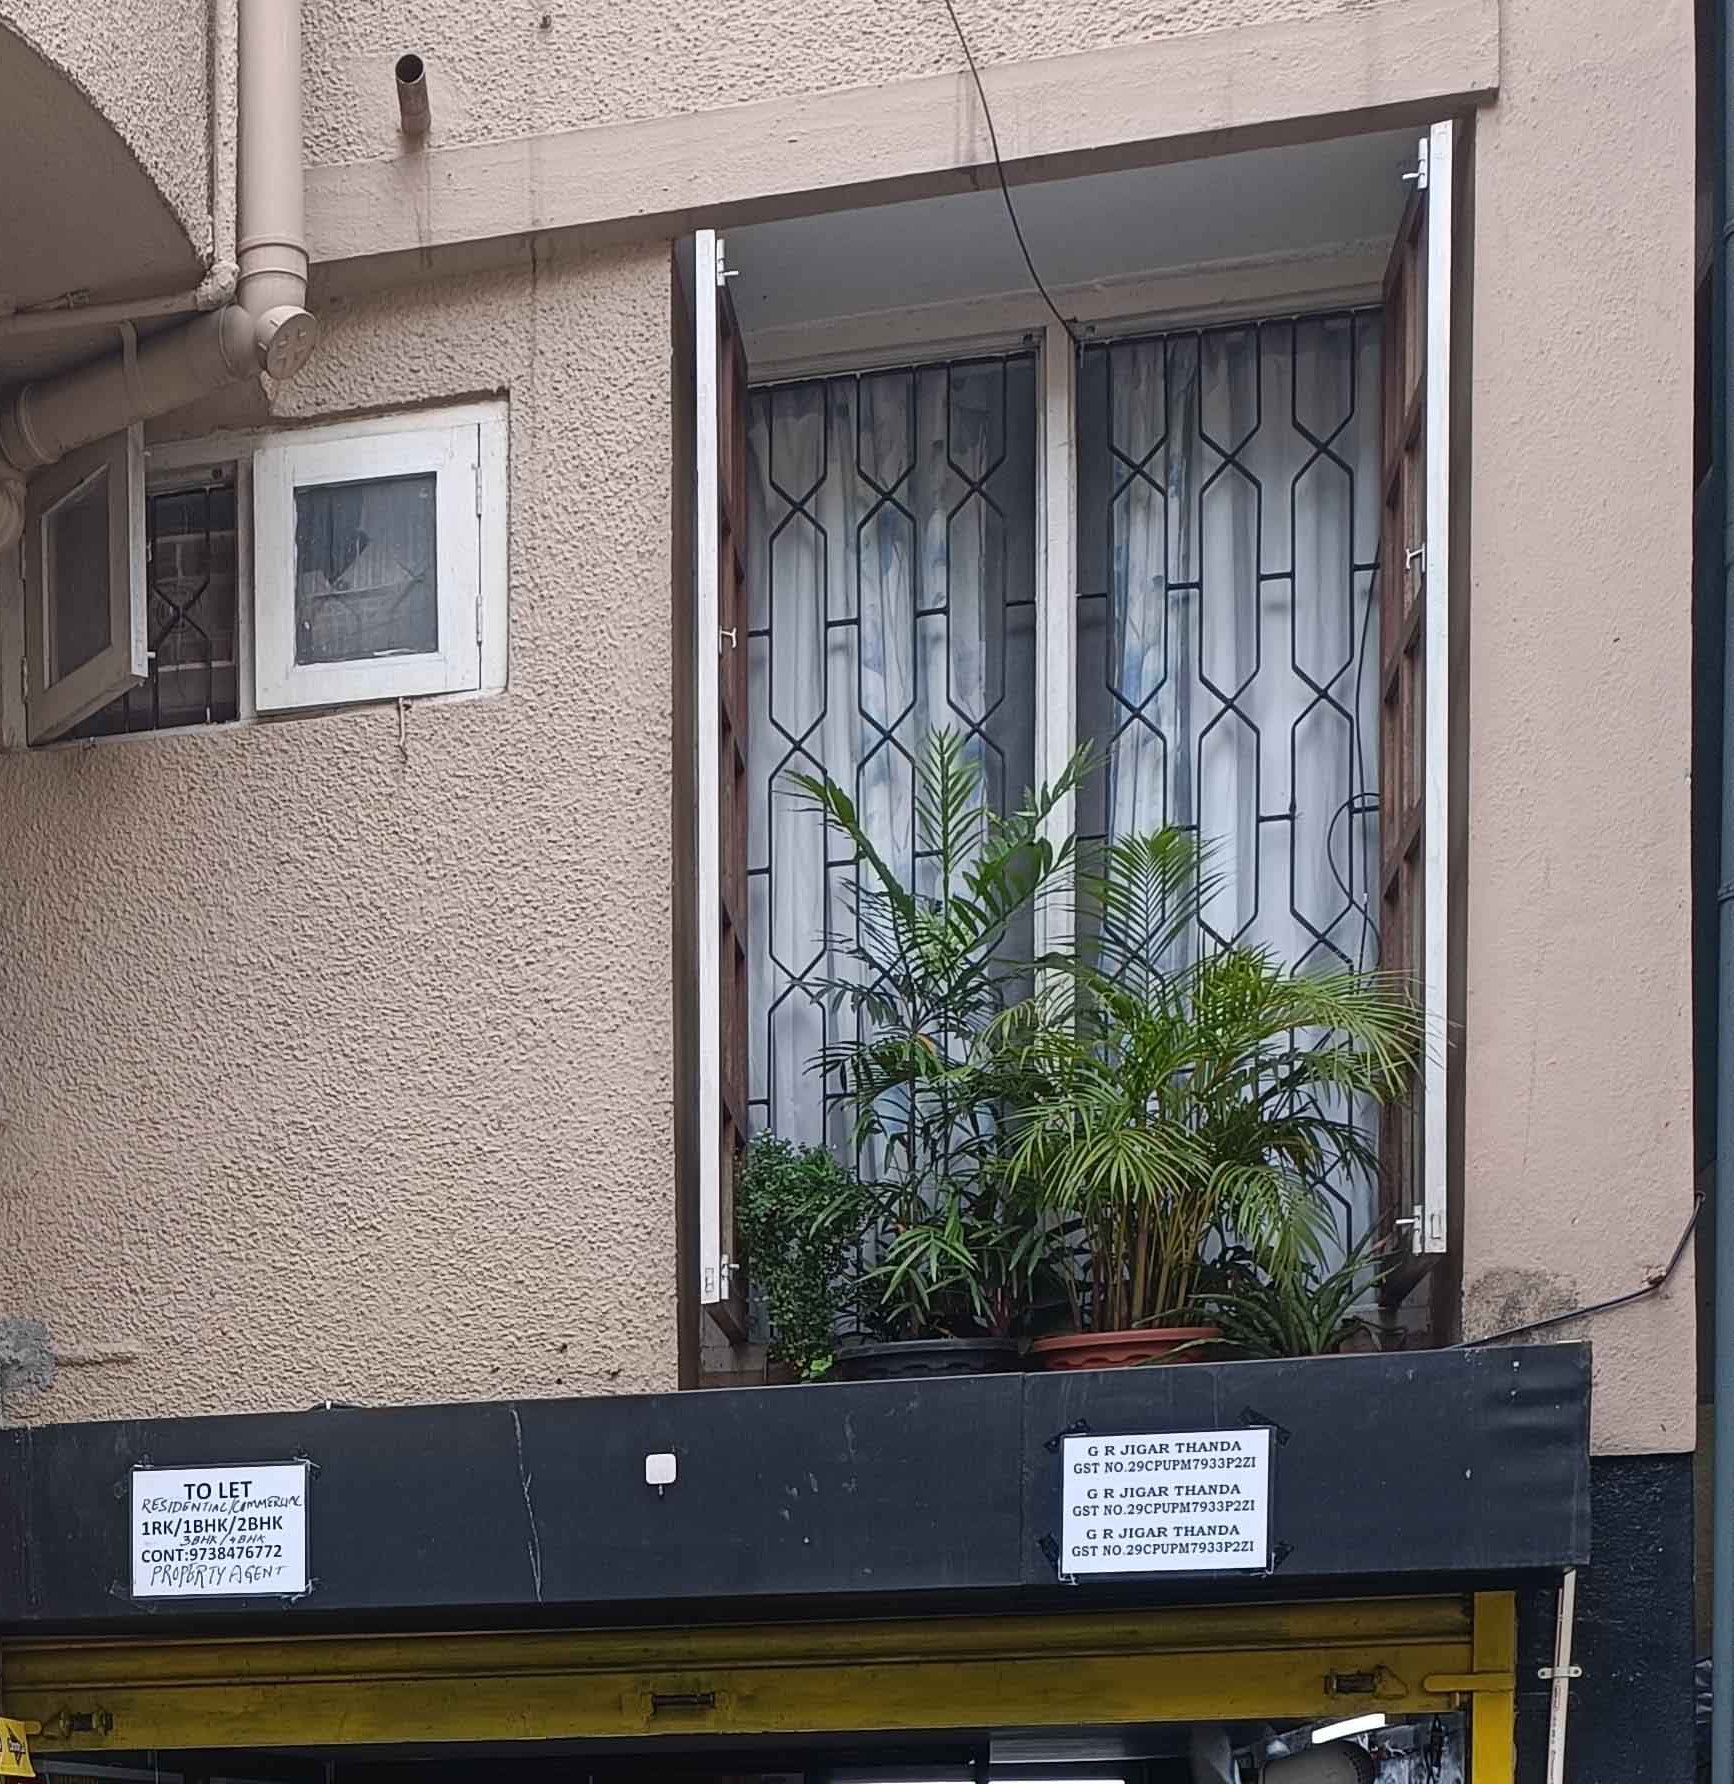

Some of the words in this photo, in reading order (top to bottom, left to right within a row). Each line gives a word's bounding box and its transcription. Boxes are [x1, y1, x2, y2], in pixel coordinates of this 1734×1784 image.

[1088, 1446, 1098, 1457] G
[1104, 1445, 1115, 1456] R
[1120, 1443, 1170, 1456] JIGAR
[1175, 1440, 1242, 1453] THANDA
[1073, 1462, 1100, 1474] GST
[183, 1482, 212, 1500] TO
[219, 1480, 253, 1499] LET
[1087, 1489, 1098, 1499] G
[1104, 1488, 1115, 1498] R
[1119, 1485, 1169, 1498] JIGAR
[1174, 1483, 1241, 1496] THANDA
[1072, 1505, 1099, 1517] GST
[141, 1515, 283, 1537] 1RK/1BHK/2BHK
[1086, 1529, 1097, 1540] G
[1103, 1528, 1114, 1539] R
[1118, 1526, 1168, 1538] JIGAR
[1173, 1524, 1240, 1537] THANDA
[141, 1544, 282, 1563] CONT:9738476772
[1072, 1546, 1099, 1557] GST
[229, 1565, 290, 1584] AGENT
